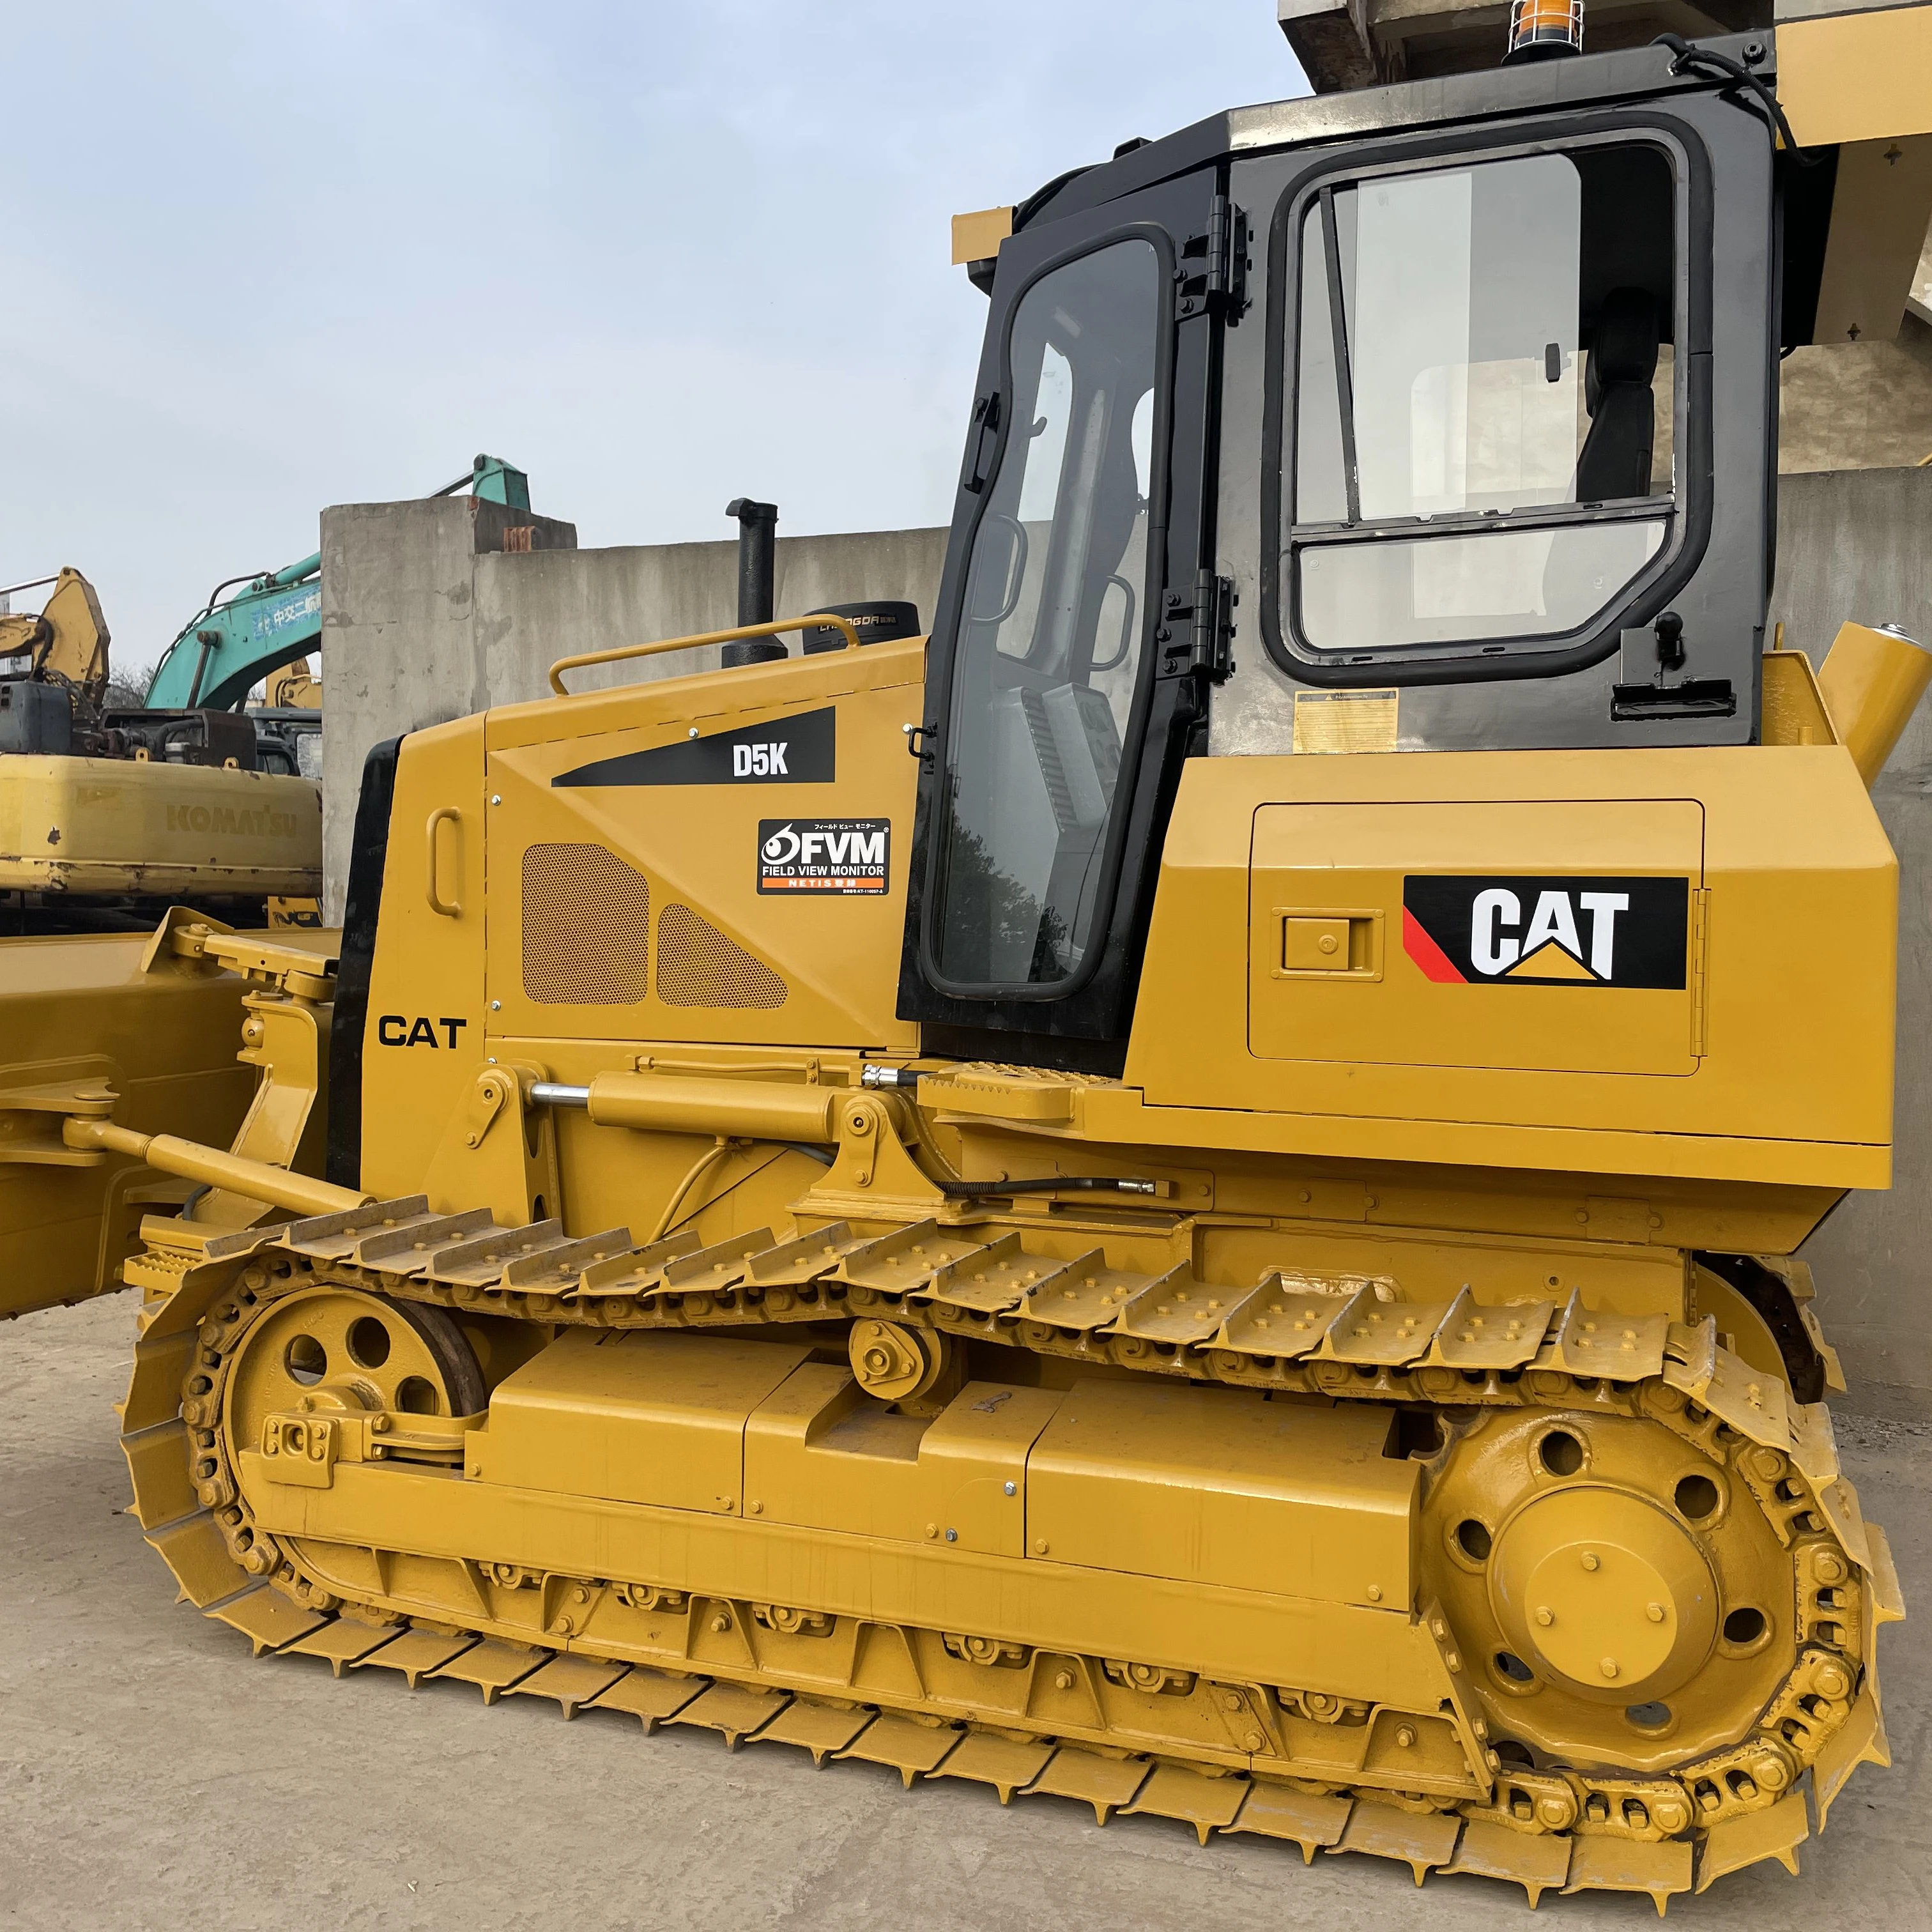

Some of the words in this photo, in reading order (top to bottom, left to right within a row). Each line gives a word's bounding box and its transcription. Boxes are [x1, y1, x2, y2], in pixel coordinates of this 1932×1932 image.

[733, 742, 788, 777] D5K
[167, 804, 297, 838] KOMATSU
[801, 832, 885, 864] FVM
[762, 866, 795, 877] FIELD
[798, 865, 828, 876] VIEW
[831, 865, 884, 876] MONITOR
[1471, 888, 1629, 981] CAT
[379, 1015, 466, 1049] CAT
